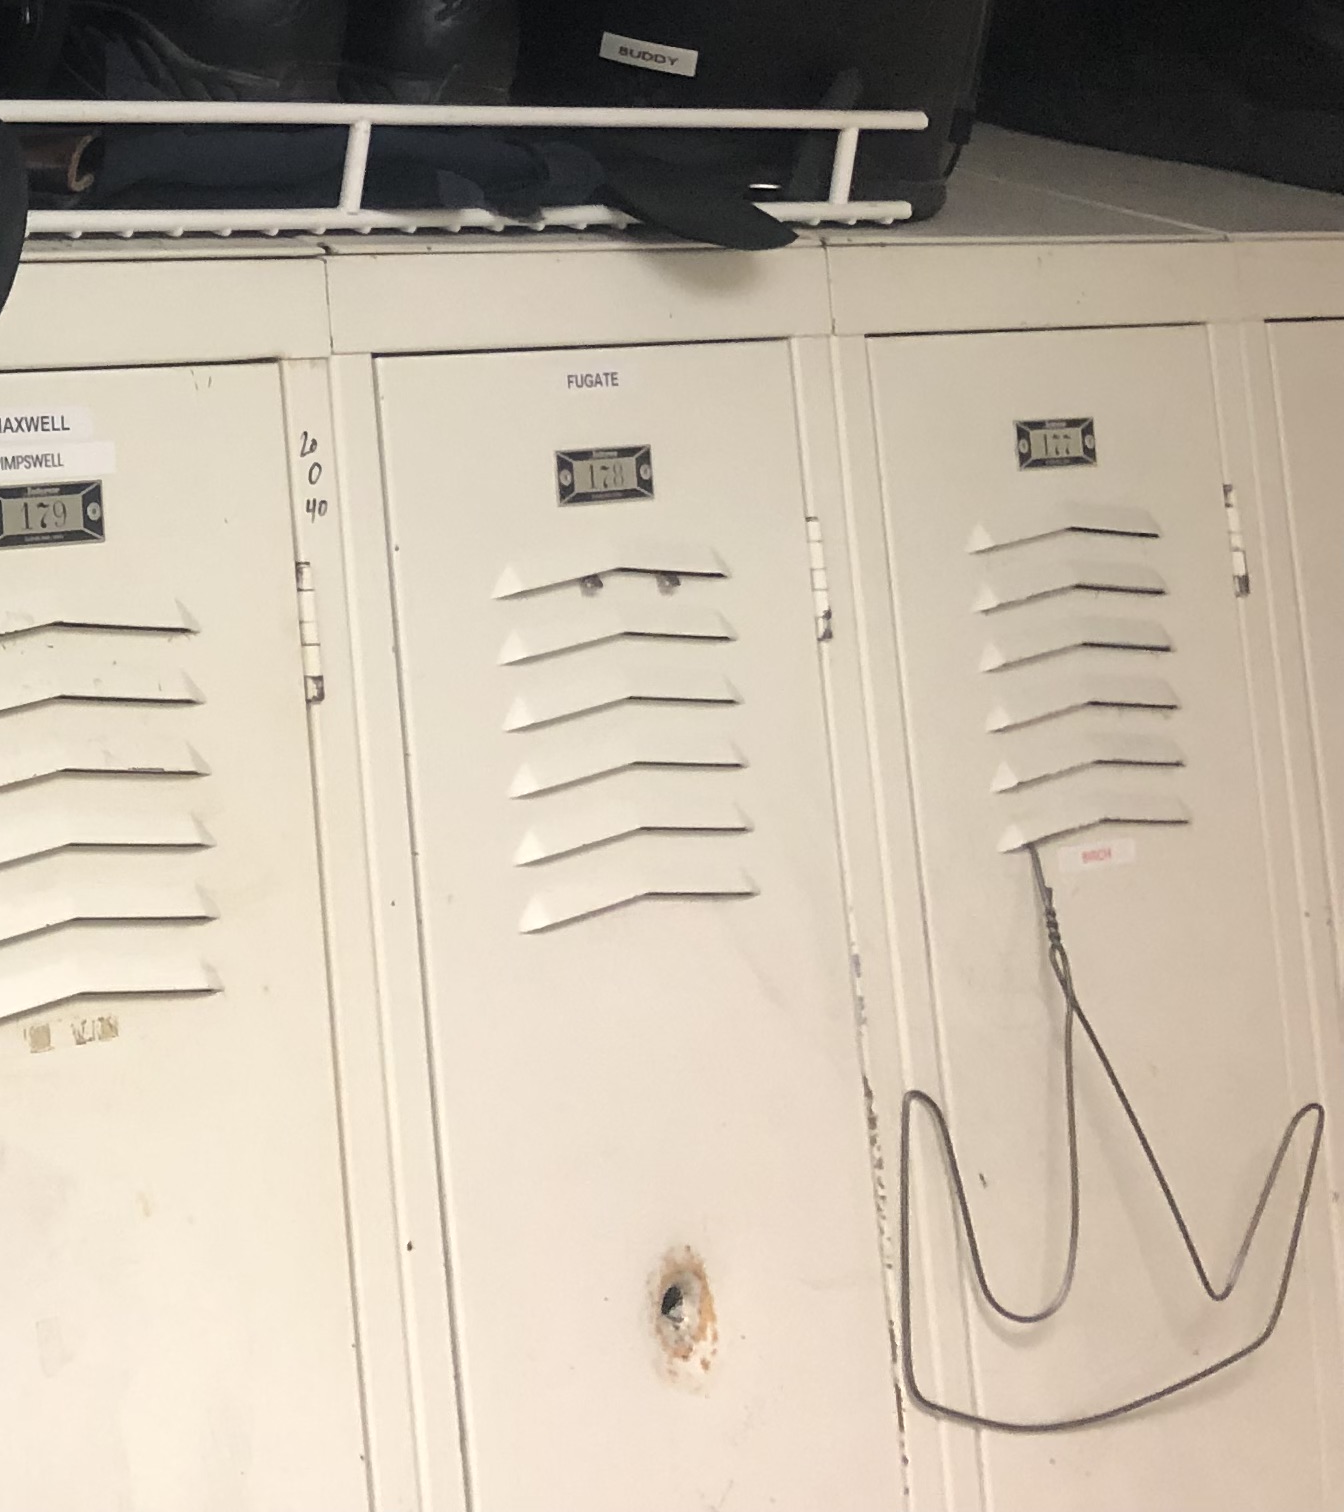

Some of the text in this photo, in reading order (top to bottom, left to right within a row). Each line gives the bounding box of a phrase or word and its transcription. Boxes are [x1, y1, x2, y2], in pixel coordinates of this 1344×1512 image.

[618, 46, 679, 66] BUDDY
[567, 372, 619, 389] FUGATE
[589, 462, 625, 489] 178
[21, 500, 67, 530] 179
[305, 498, 328, 524] 40
